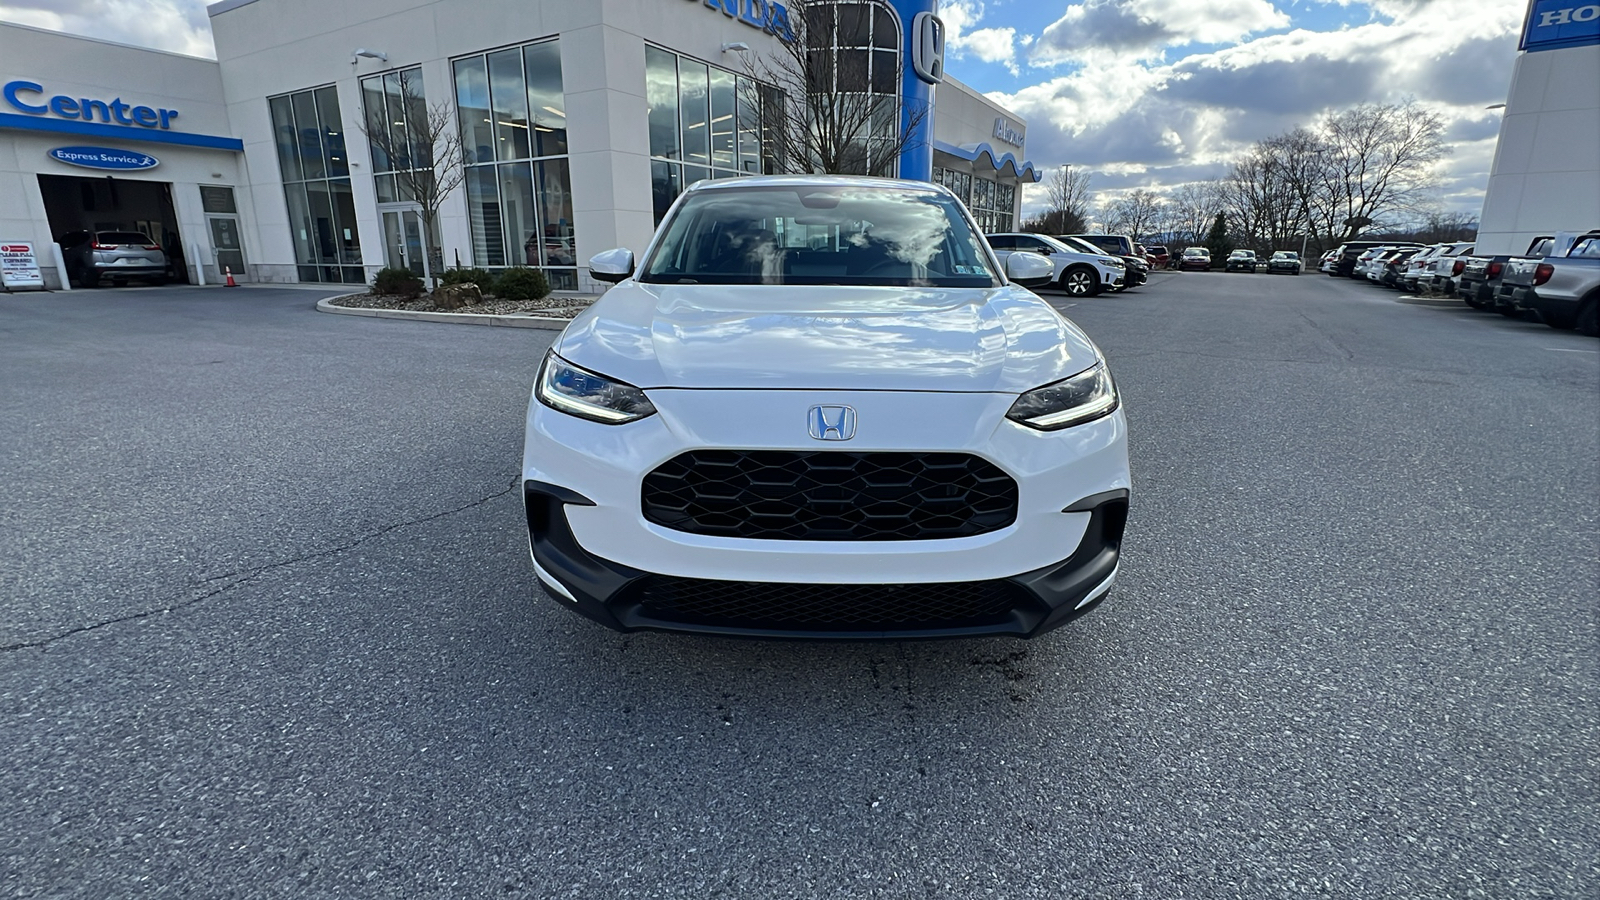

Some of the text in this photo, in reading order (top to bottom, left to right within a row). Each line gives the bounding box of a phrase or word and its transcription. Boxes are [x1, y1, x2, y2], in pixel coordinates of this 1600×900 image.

[3, 80, 179, 129] Center
[56, 150, 138, 164] Express Service
